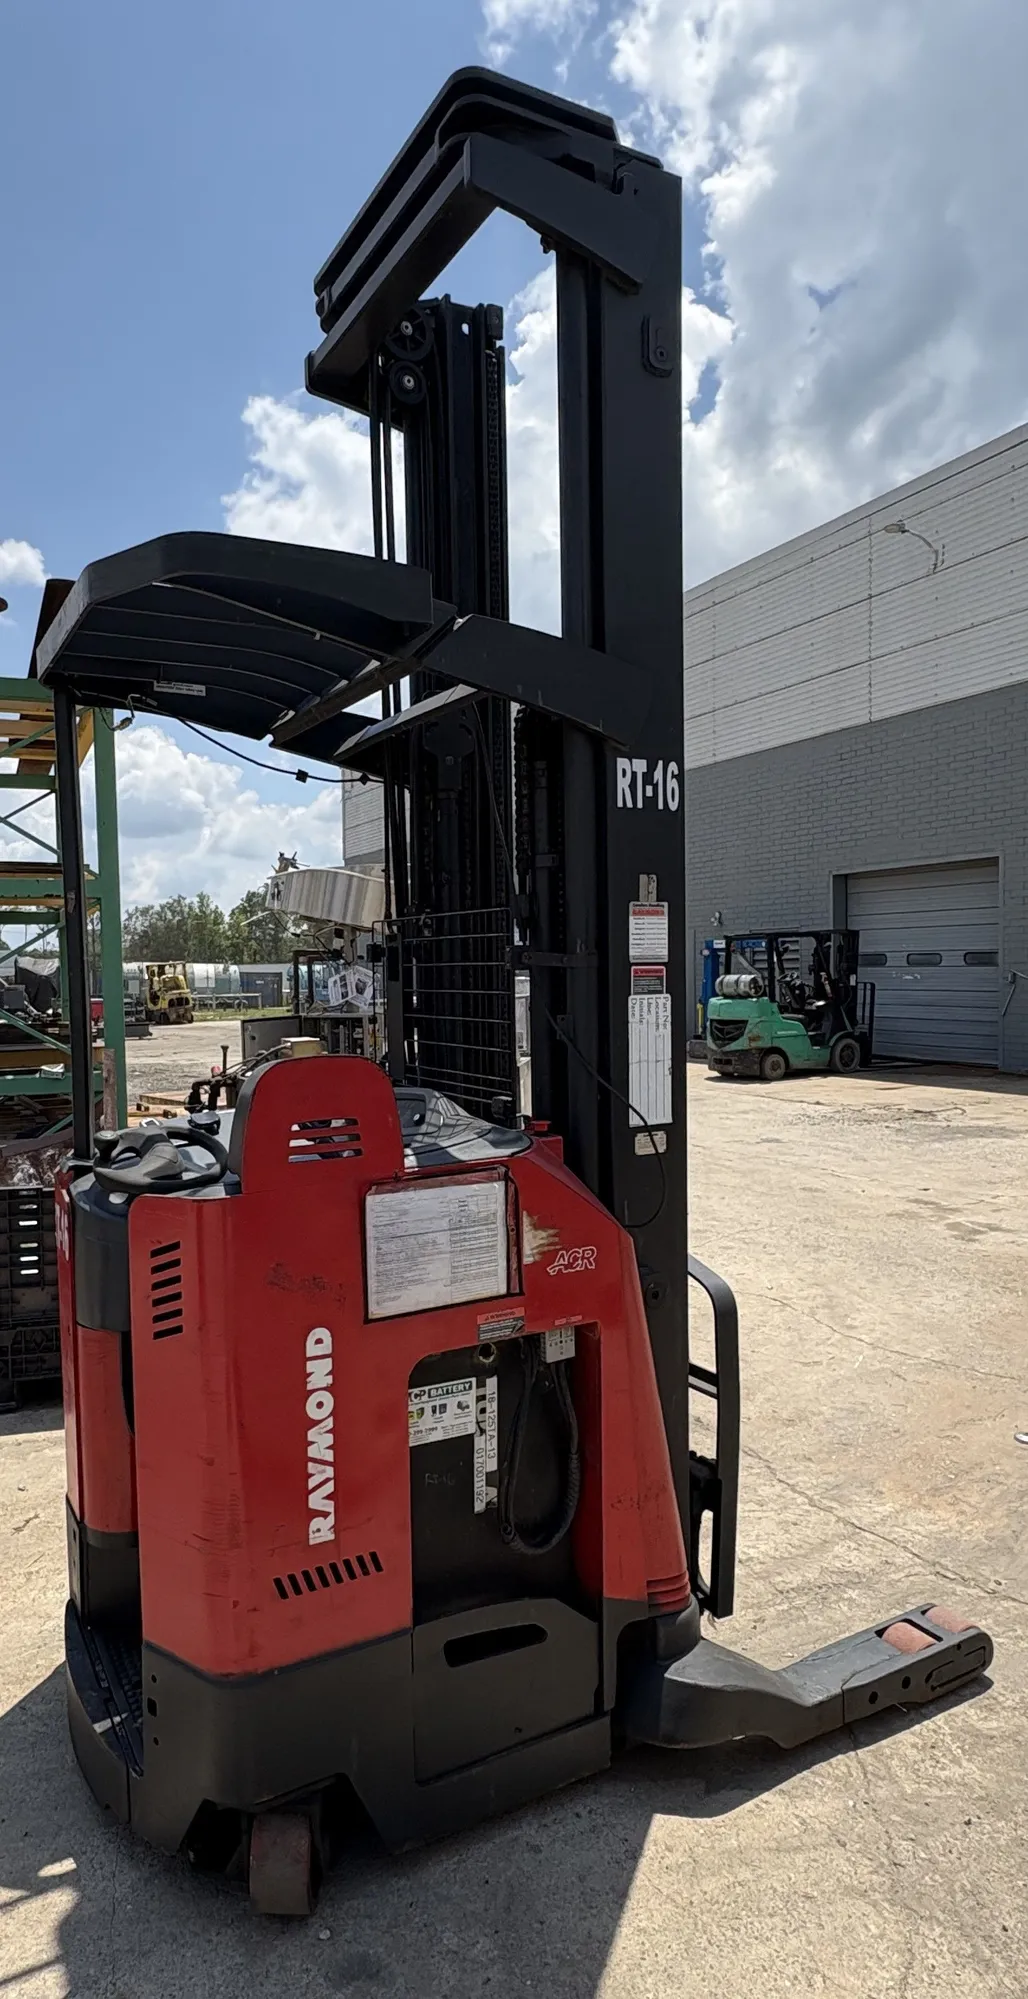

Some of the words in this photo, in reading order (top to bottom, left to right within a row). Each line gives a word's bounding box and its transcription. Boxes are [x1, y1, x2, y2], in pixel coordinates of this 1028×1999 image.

[616, 757, 679, 812] RT-16
[630, 998, 638, 1020] Date:
[662, 996, 670, 1012] Part
[546, 1246, 597, 1275] ACR
[430, 1382, 471, 1397] BATTERY
[305, 1327, 335, 1545] RAYMOND
[476, 1448, 485, 1504] 017001192
